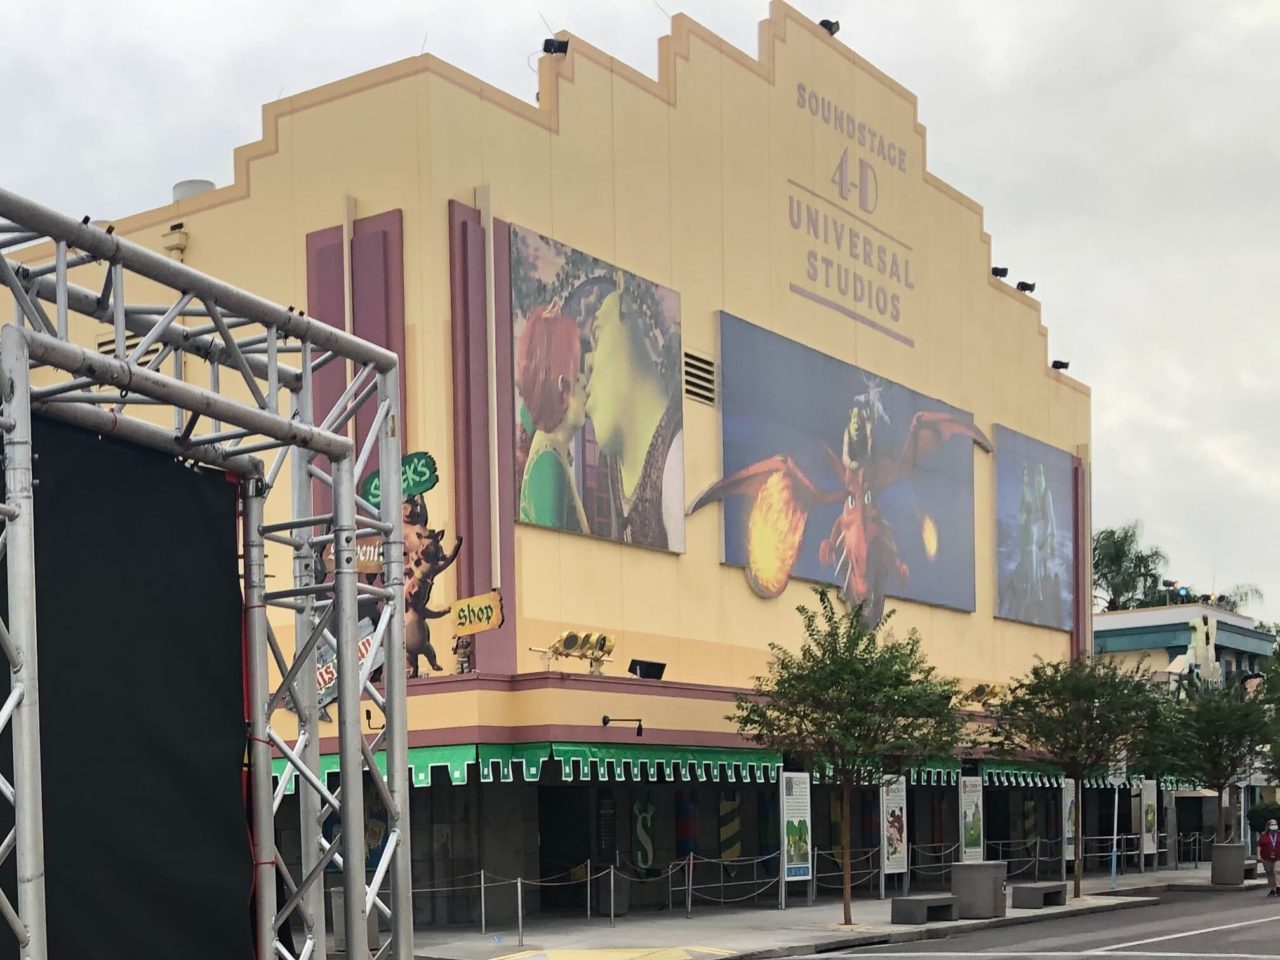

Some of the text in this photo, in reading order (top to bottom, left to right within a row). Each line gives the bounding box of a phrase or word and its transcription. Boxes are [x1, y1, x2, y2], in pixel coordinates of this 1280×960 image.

[796, 82, 907, 173] SOUNDSTAGE
[830, 146, 879, 215] 4-D
[788, 195, 915, 290] UNIVERSAL
[806, 249, 901, 323] STUDIOS
